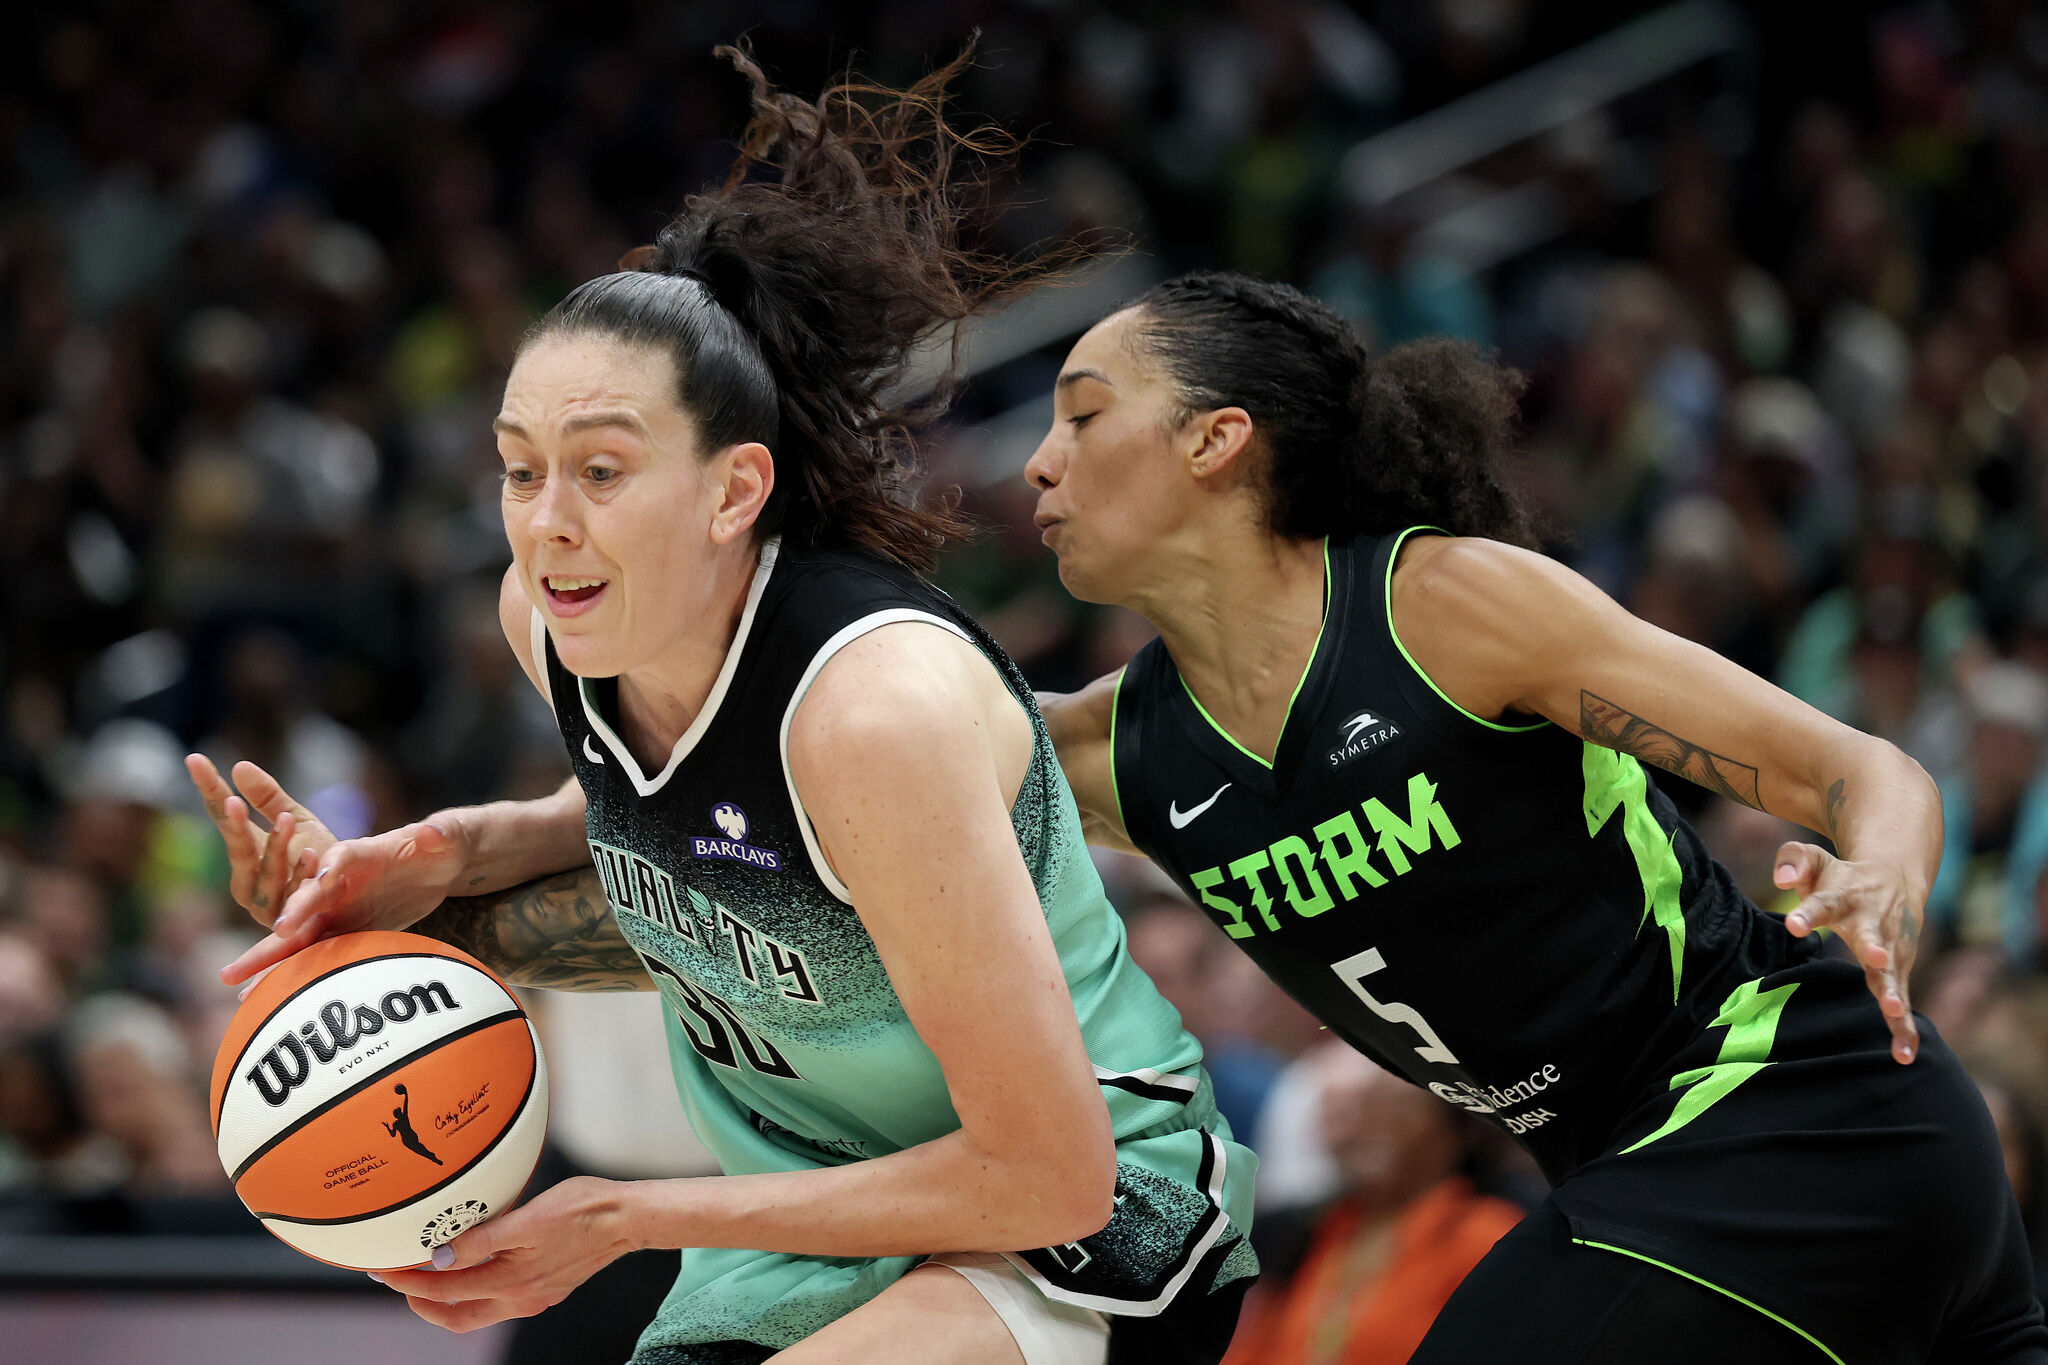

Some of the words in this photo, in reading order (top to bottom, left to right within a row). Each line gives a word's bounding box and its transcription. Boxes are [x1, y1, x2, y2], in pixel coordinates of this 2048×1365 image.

[1330, 725, 1400, 766] SYMETRA
[695, 839, 777, 868] BARCLAYS
[1190, 772, 1462, 940] STORM
[1330, 946, 1460, 1064] 5
[245, 979, 461, 1108] Wilson
[338, 1056, 363, 1075] EVO
[366, 1040, 390, 1058] NXT
[323, 1172, 358, 1189] GAME
[357, 1159, 389, 1176] BALL
[325, 1154, 377, 1178] OFFICIAL
